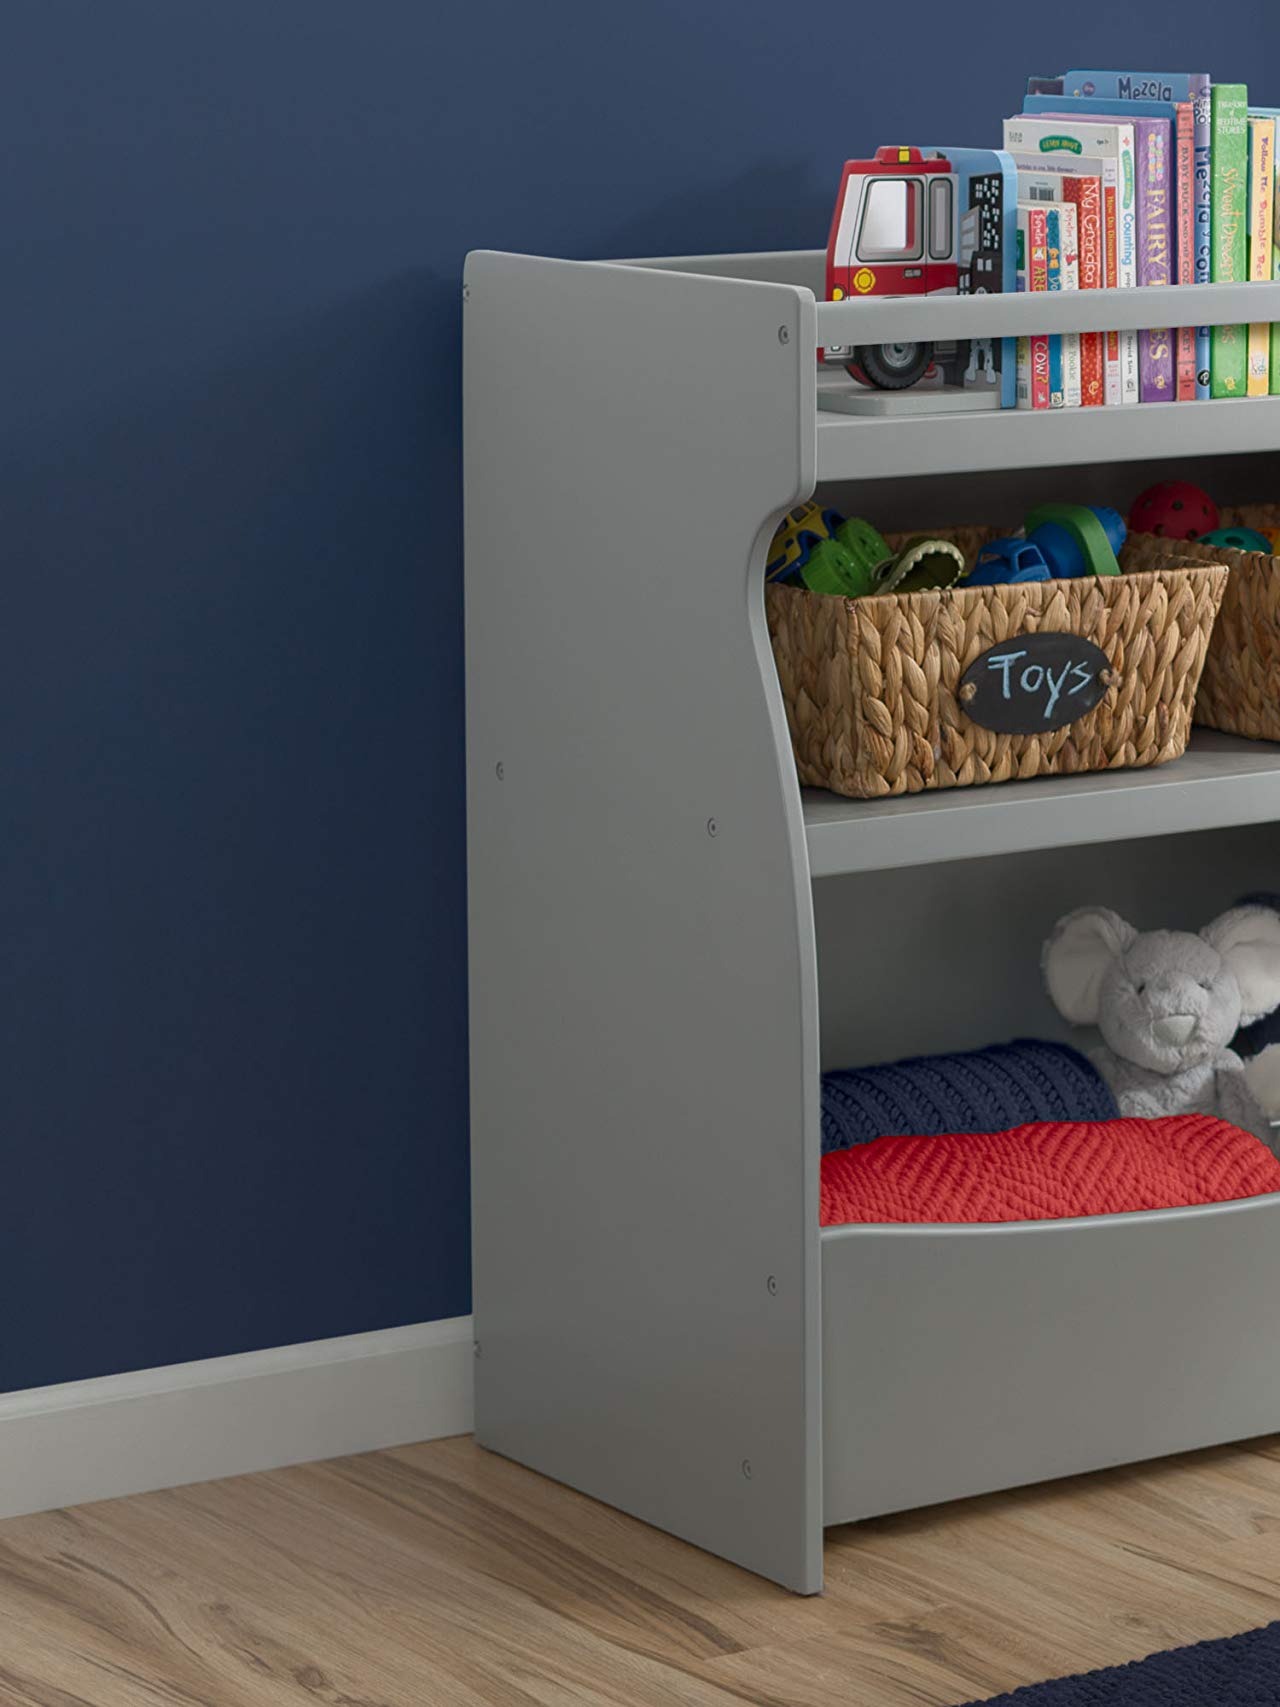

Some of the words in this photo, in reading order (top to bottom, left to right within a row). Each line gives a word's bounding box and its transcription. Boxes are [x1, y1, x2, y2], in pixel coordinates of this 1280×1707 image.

[1117, 76, 1172, 102] Mezcla
[1181, 146, 1190, 178] BABY
[1081, 181, 1099, 209] My
[1107, 195, 1115, 214] How
[1181, 182, 1190, 217] DUCK
[1107, 216, 1115, 228] Do
[1122, 212, 1135, 266] Counting
[1146, 188, 1167, 268] FAIRY
[1257, 199, 1268, 250] Bumble
[1081, 214, 1100, 284] Grandpa
[1107, 230, 1116, 270] Dinosaurs
[1256, 254, 1266, 278] Bee
[1182, 260, 1191, 284] COZ
[1034, 341, 1049, 384] COW?
[987, 651, 1095, 721] Toys
